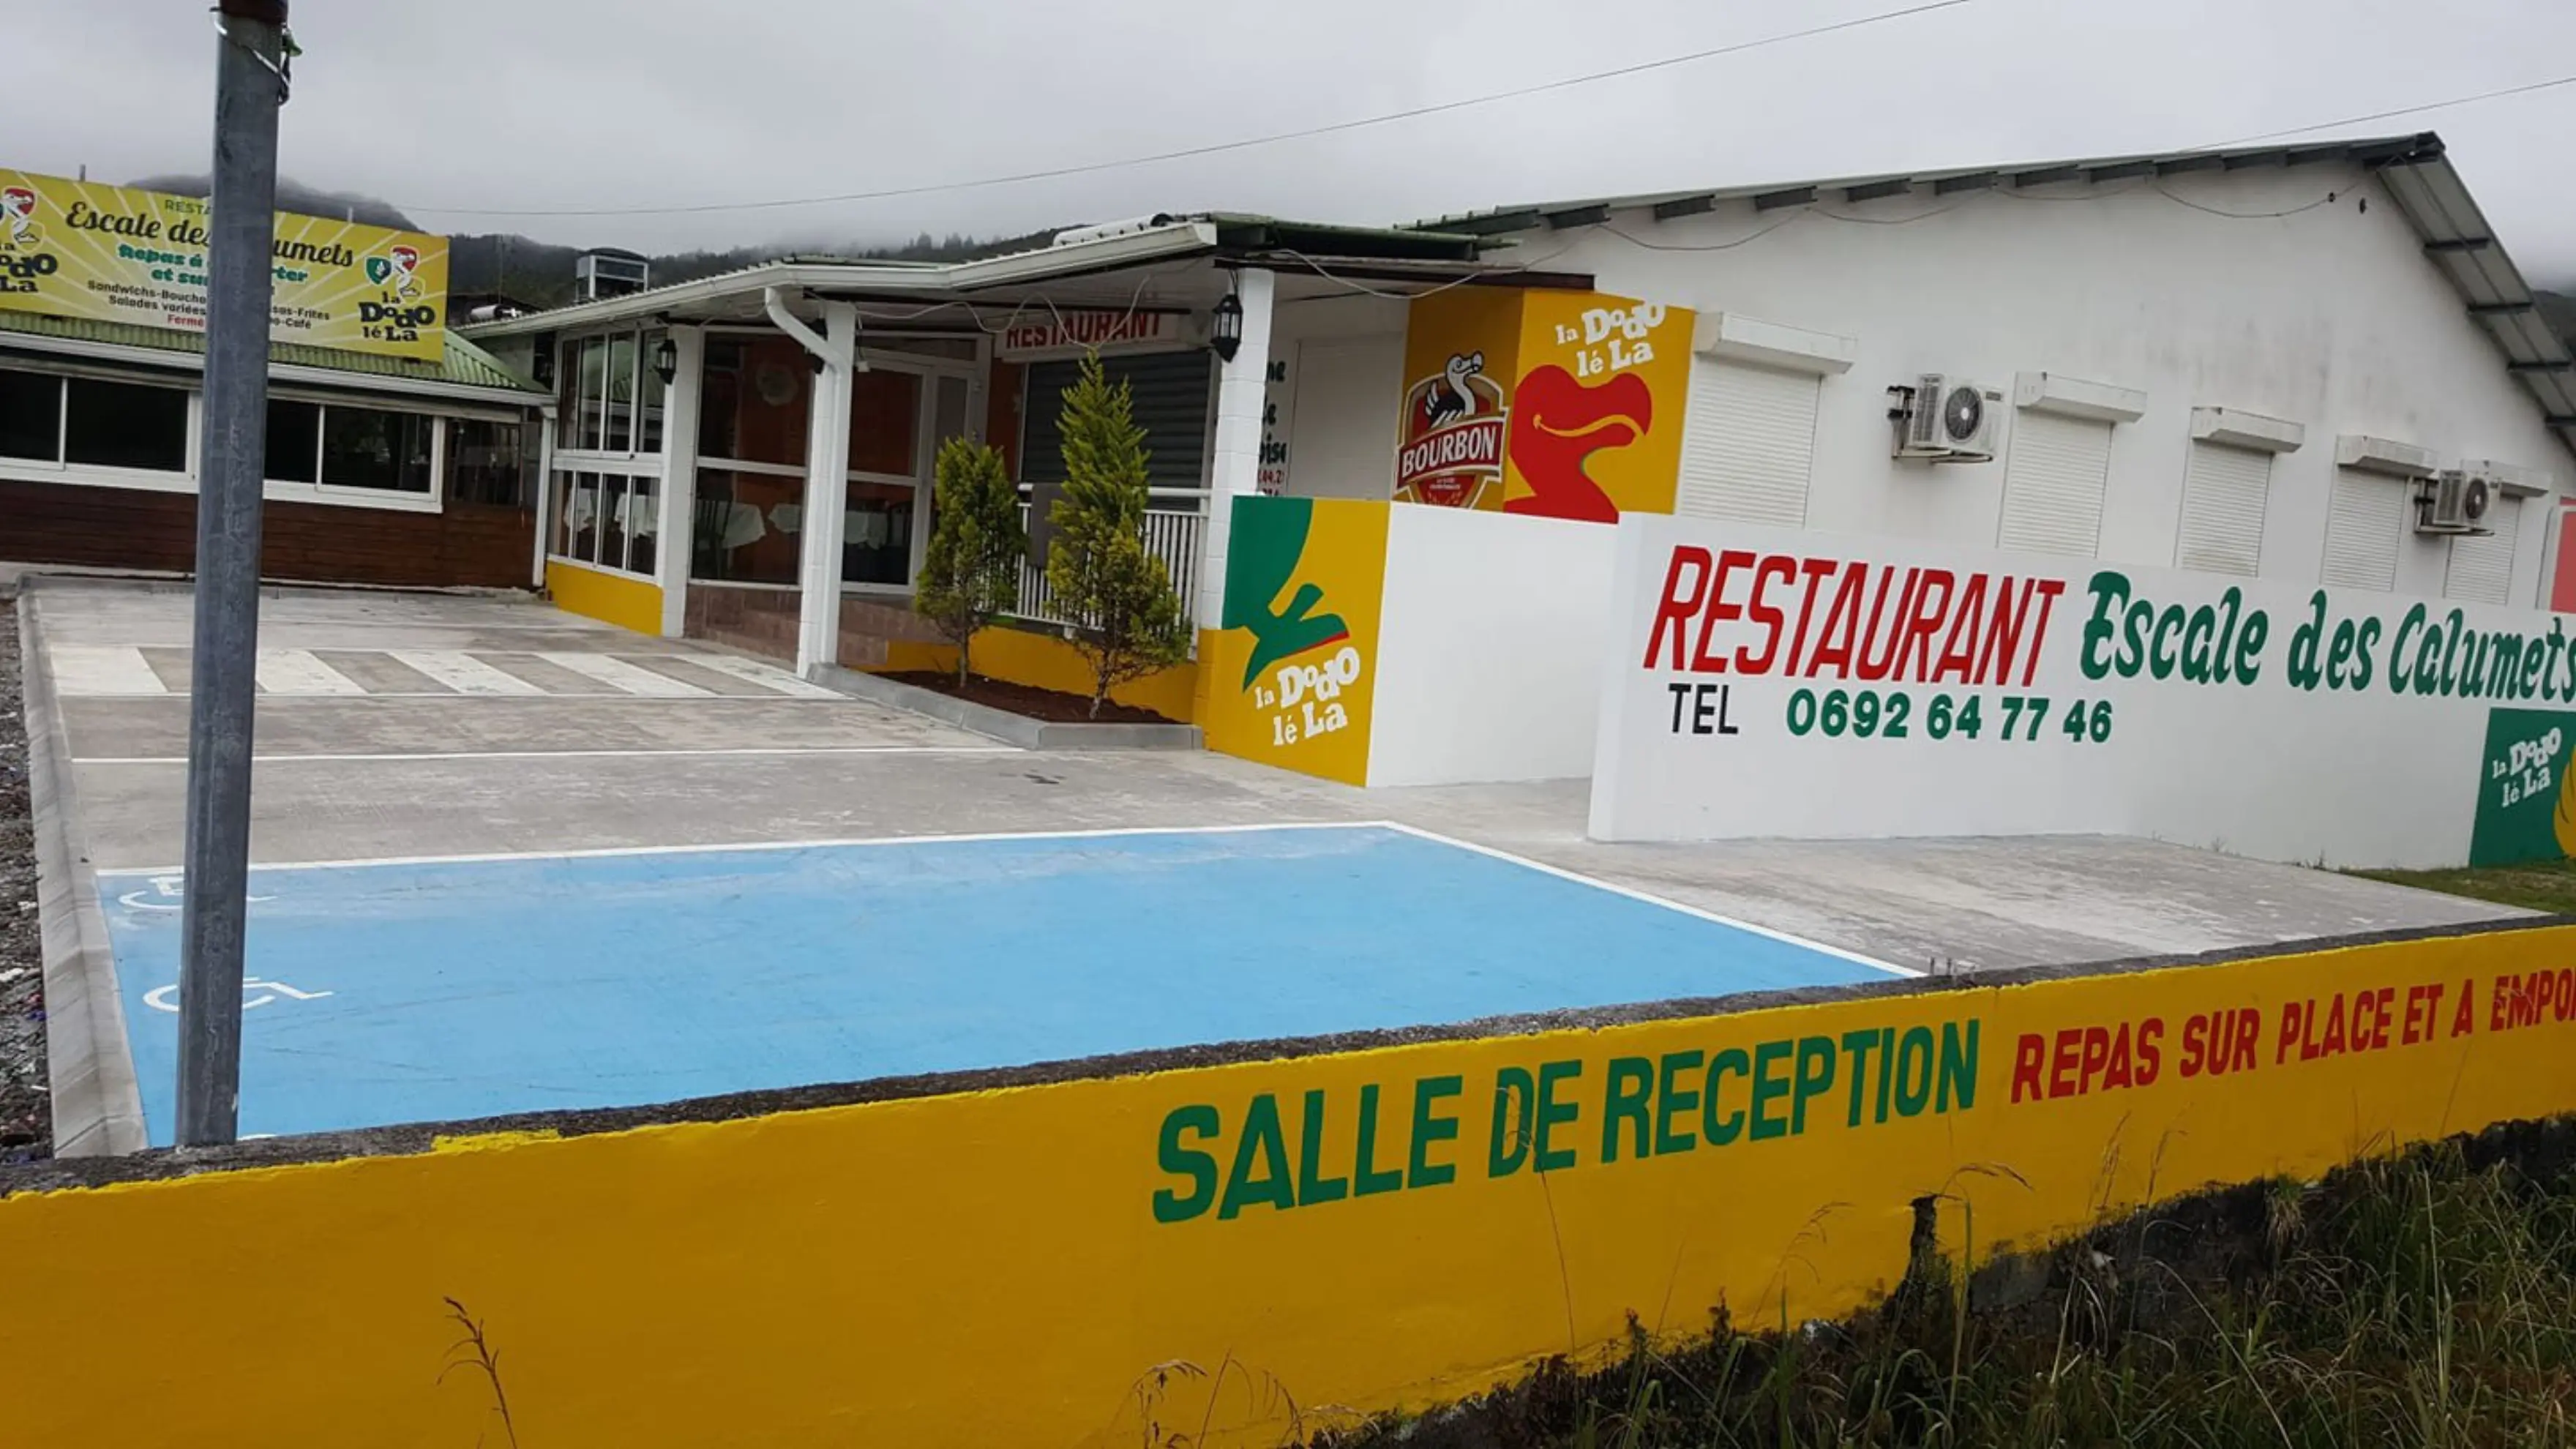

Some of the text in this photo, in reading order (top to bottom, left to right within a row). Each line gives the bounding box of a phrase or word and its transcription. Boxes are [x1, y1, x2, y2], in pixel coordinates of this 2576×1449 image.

[66, 201, 161, 239] Escale
[273, 239, 353, 267] umets
[118, 244, 186, 263] Repas
[151, 268, 174, 282] et
[109, 295, 158, 310] Salades
[382, 291, 401, 304] la
[363, 326, 419, 342] lé La
[1556, 324, 1579, 345] la
[1576, 337, 1655, 378] lé La
[1401, 426, 1497, 474] BOURBON
[1642, 544, 2576, 704] RESTAURANT Escale des Calumets
[1255, 686, 1275, 710] la
[1668, 682, 2113, 744] TEL 0692 64 77 46
[1273, 700, 1349, 746] lé La
[2492, 760, 2507, 779] la
[2501, 766, 2551, 808] lé La
[1152, 967, 2576, 1224] SALLE DE RECEPTION REPAS SUR PLACE ET A EMPO
